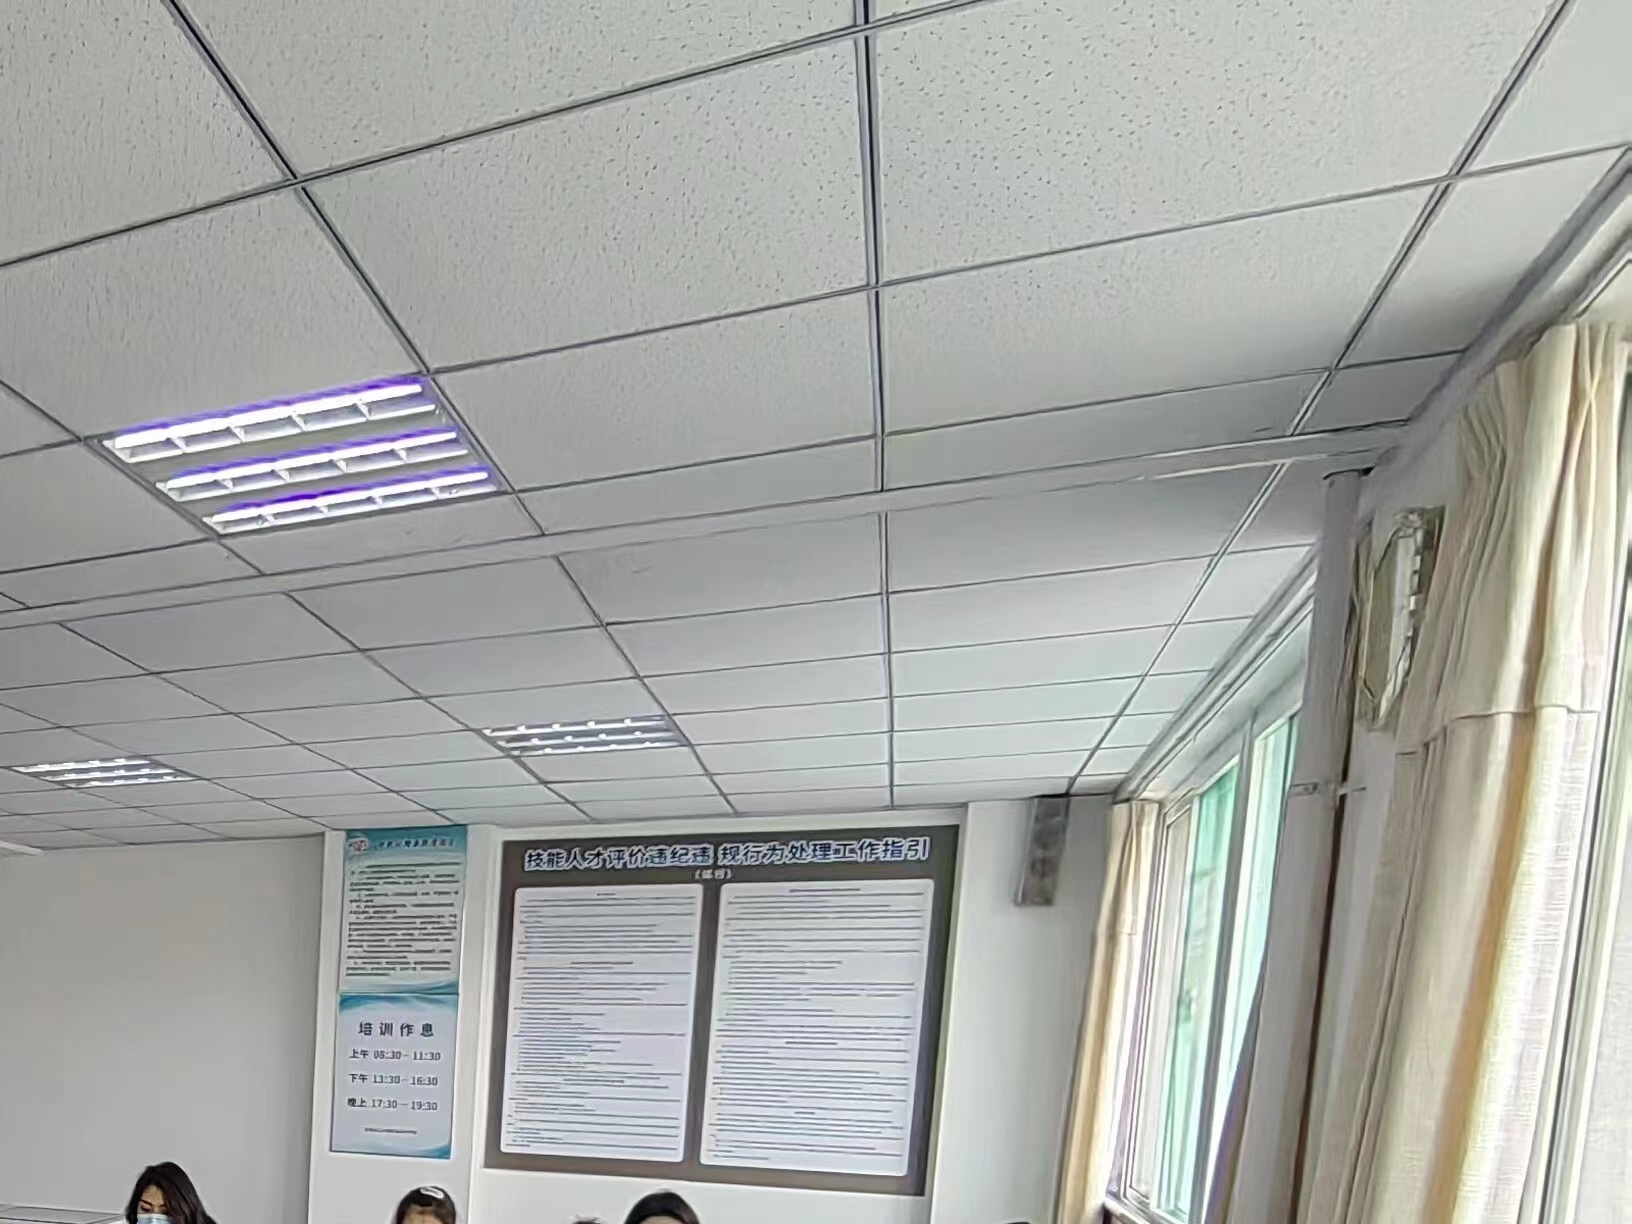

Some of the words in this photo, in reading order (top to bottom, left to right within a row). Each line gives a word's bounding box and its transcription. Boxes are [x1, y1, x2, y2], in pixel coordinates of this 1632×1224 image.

[358, 1021, 434, 1037] 培训作息
[349, 1048, 369, 1059] 上午
[348, 1073, 368, 1083] 下午
